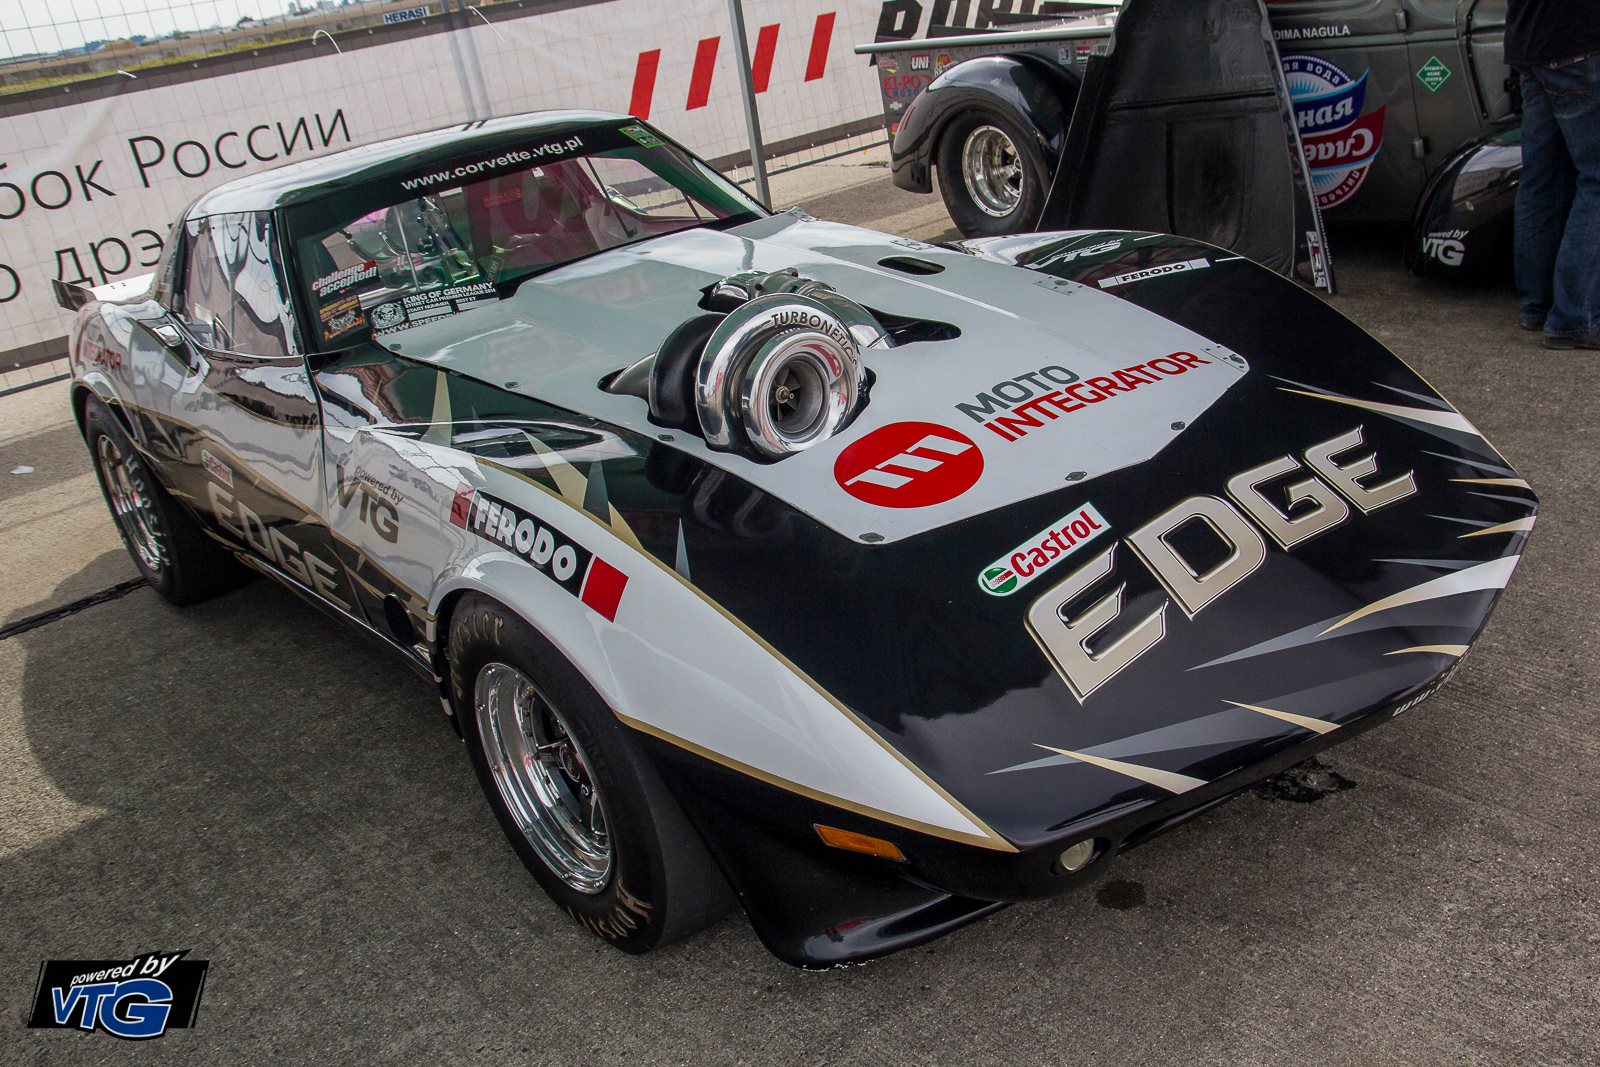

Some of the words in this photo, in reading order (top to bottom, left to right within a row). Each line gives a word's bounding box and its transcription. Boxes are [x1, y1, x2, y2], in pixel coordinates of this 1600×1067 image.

[1302, 24, 1350, 39] NAGULA
[911, 56, 929, 70] UNI
[1306, 62, 1341, 85] вода
[128, 108, 352, 189] России
[401, 136, 583, 191] www.corvette.vtg.pl
[53, 222, 174, 289] дрэ
[1423, 237, 1466, 266] VTG
[1452, 229, 1470, 240] by
[312, 263, 365, 291] challenge
[319, 265, 377, 297] accepted!
[402, 293, 429, 304] KING
[429, 290, 444, 299] OF
[443, 281, 493, 297] GERMANY
[1121, 262, 1186, 283] FERODO
[954, 365, 1080, 424] MOTO
[984, 350, 1213, 443] INTEGRATOR
[336, 464, 400, 544] VTG
[354, 465, 392, 495] powered
[390, 484, 404, 506] by
[206, 482, 353, 610] EDGE
[474, 496, 577, 582] FERODO
[1010, 509, 1103, 578] Castrol
[1024, 424, 1418, 706] EDGE
